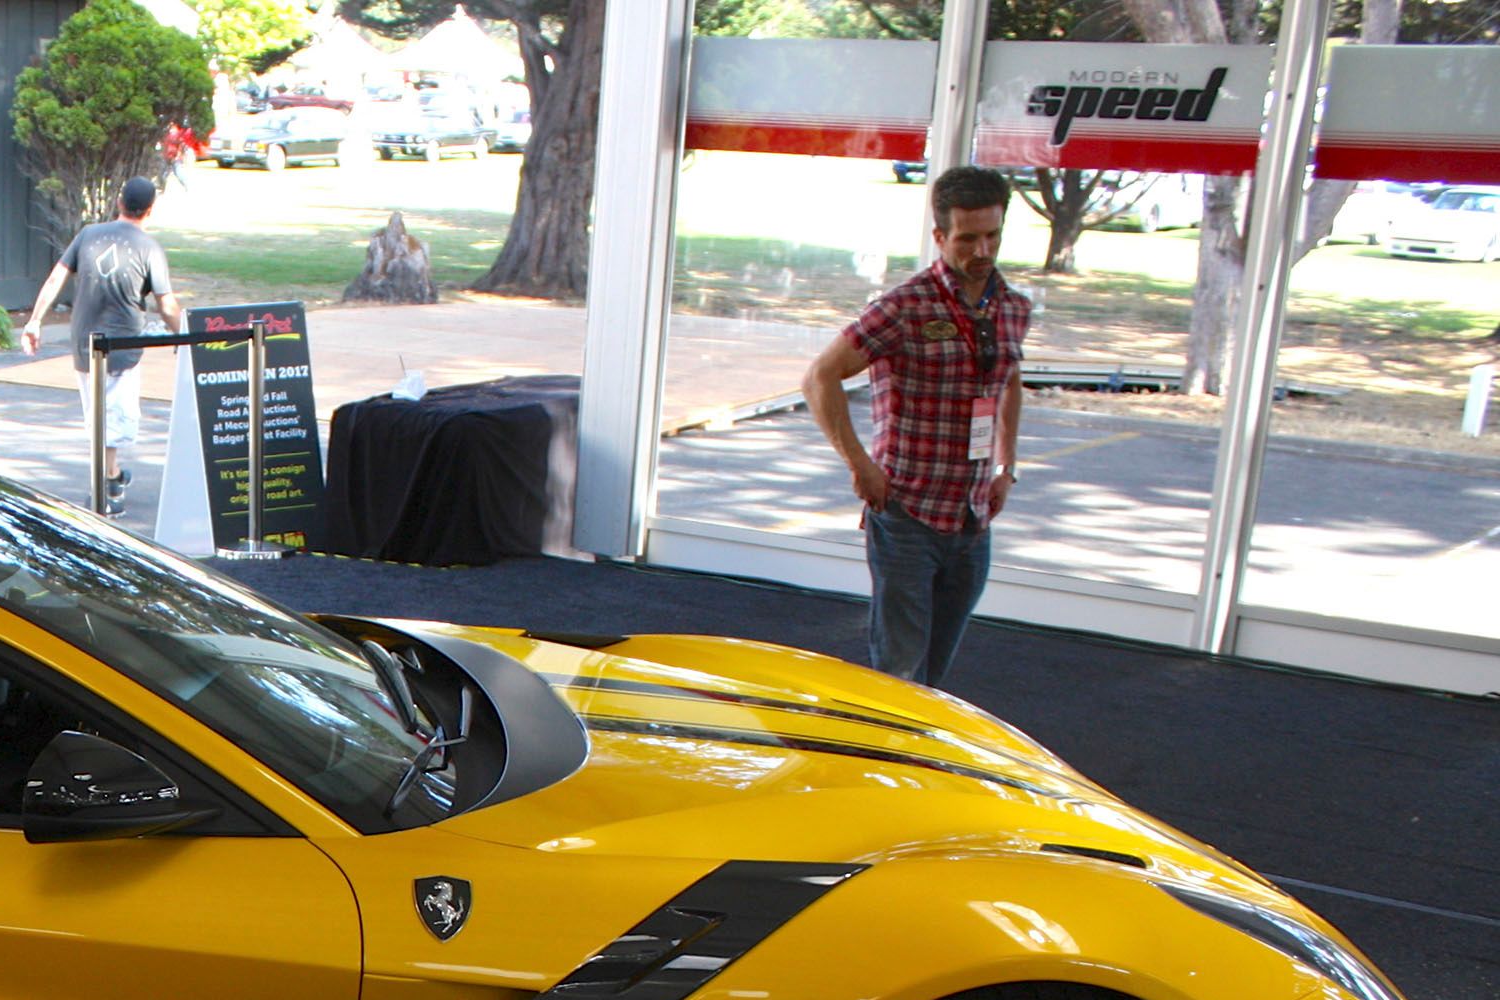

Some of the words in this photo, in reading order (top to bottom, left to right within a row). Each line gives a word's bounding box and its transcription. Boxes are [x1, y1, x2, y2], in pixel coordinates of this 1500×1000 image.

[1069, 70, 1180, 84] MODERN
[1026, 67, 1228, 145] speed
[197, 369, 249, 385] COMIN
[278, 365, 309, 379] 2017
[271, 391, 288, 401] Fall
[217, 408, 241, 418] Road
[263, 404, 297, 415] uctions
[213, 423, 223, 432] at
[225, 420, 249, 431] Mecu
[263, 415, 301, 427] uctions'
[213, 433, 245, 445] Badger
[276, 427, 307, 439] Facility
